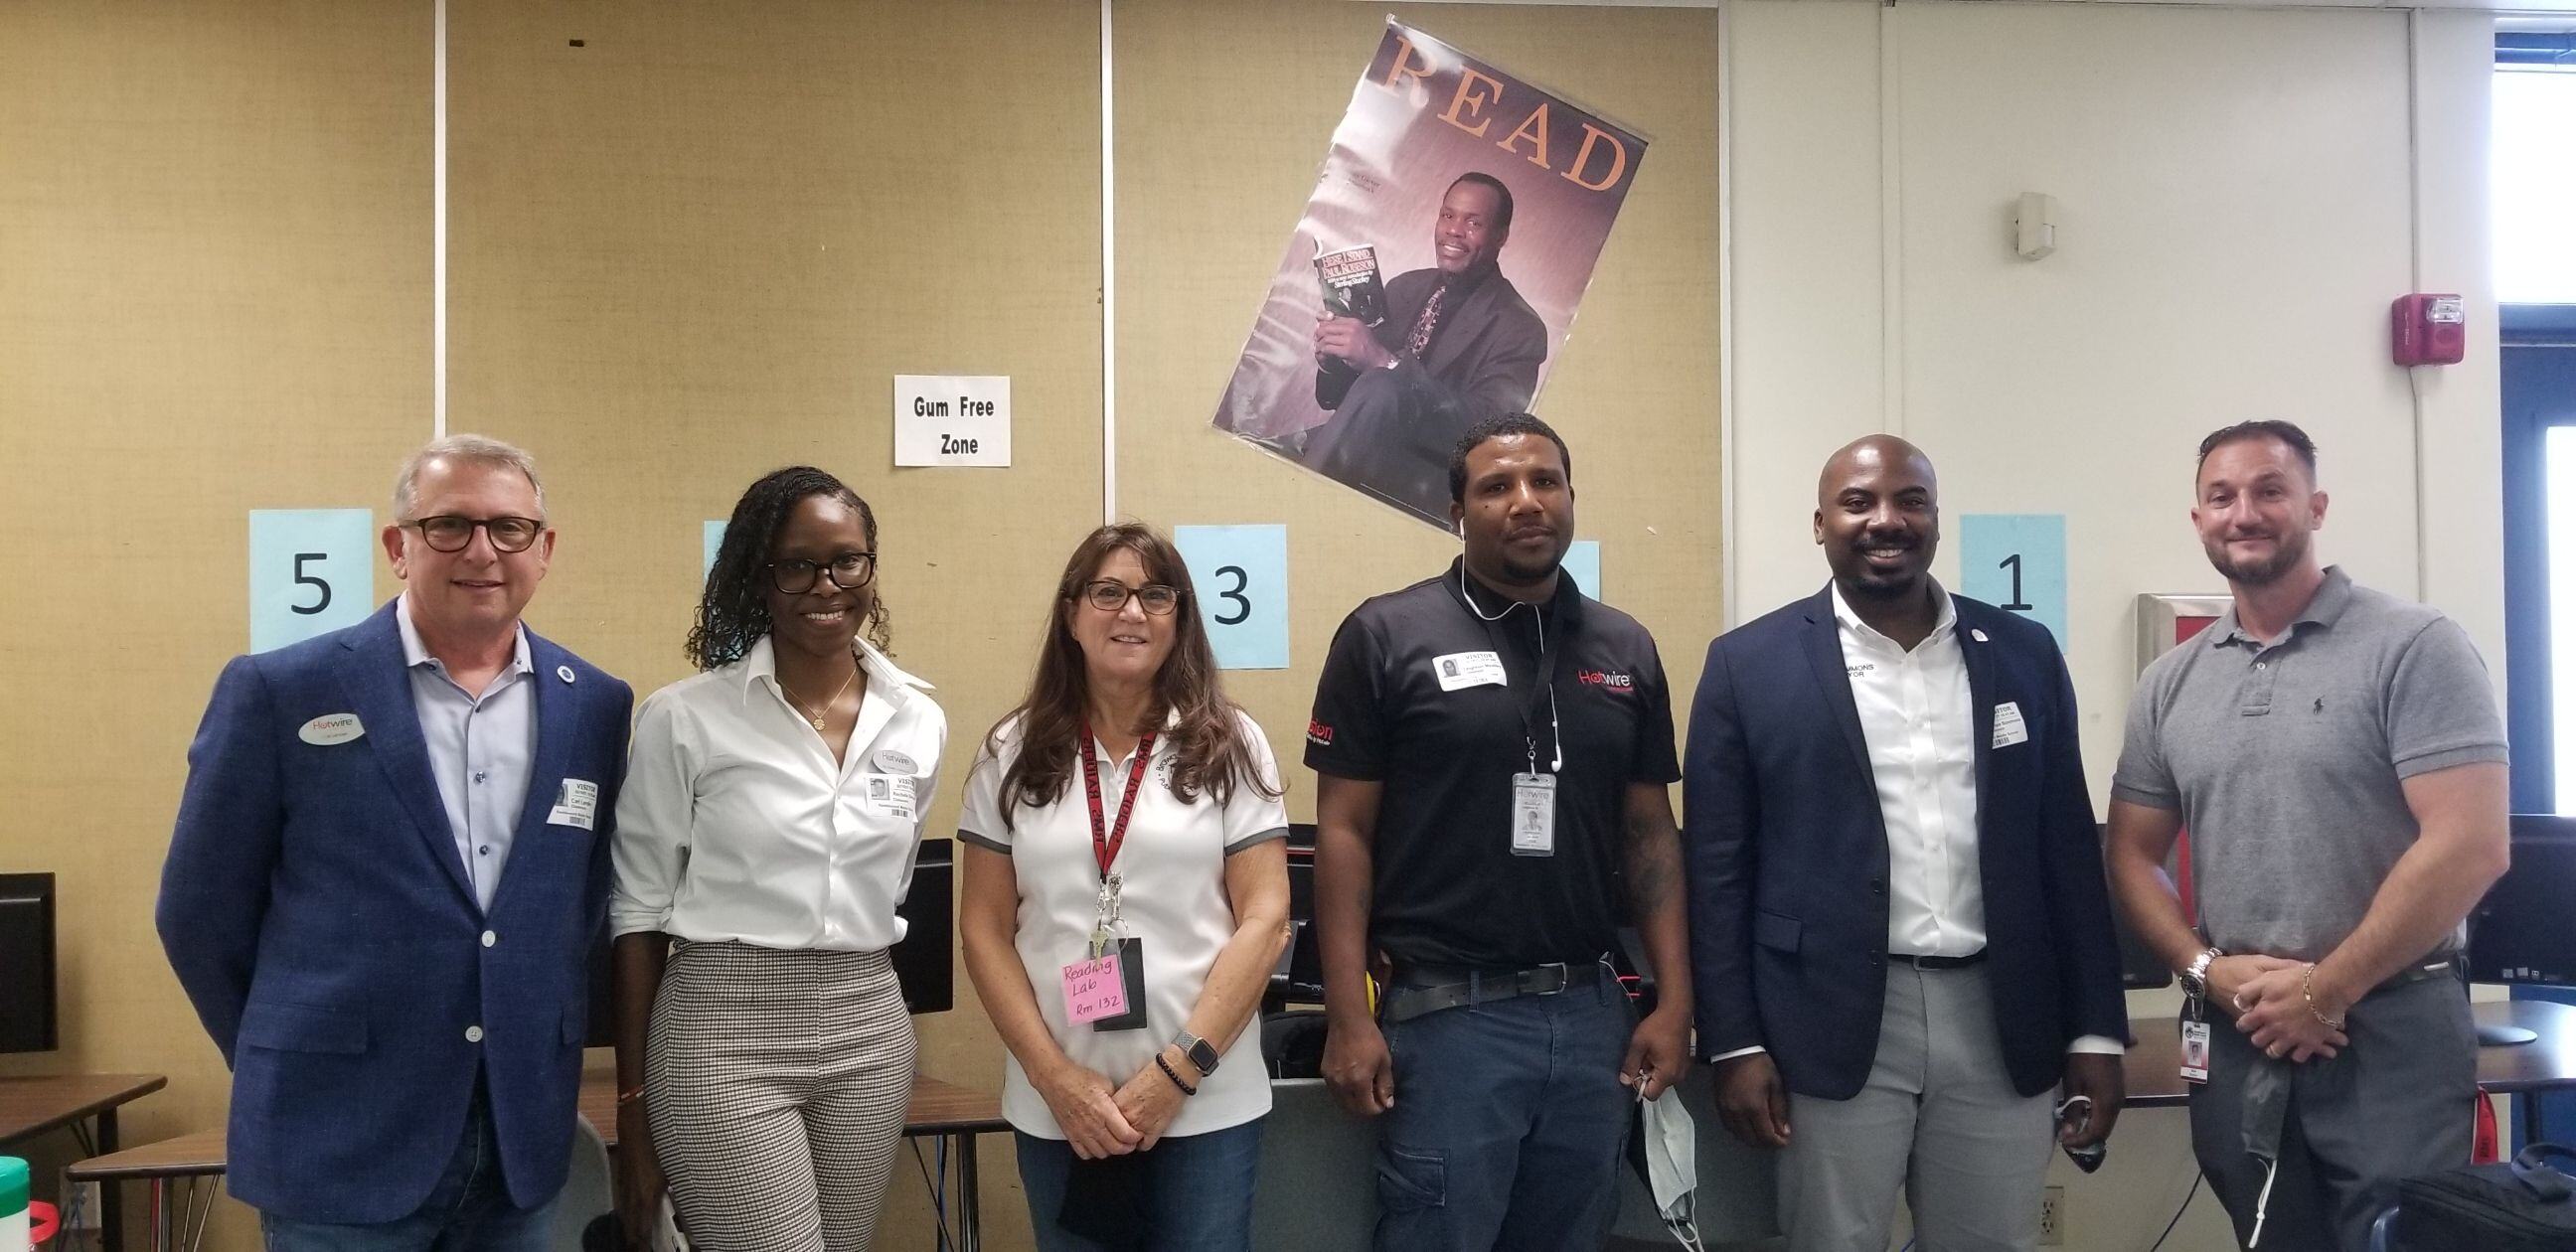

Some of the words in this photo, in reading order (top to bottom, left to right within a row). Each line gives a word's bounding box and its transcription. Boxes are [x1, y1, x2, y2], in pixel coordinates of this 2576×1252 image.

[1375, 35, 1626, 191] READ
[914, 396, 948, 417] Gum
[960, 396, 994, 416] Free
[941, 434, 978, 454] Zone
[290, 552, 332, 615] 5
[2000, 553, 2033, 610] 1
[1214, 565, 1251, 625] 3
[1578, 670, 1631, 687] Hotwire
[312, 717, 353, 729] Hotwire
[1072, 979, 1097, 997] Lab
[1076, 1005, 1093, 1017] Rm
[1098, 996, 1120, 1009] 132
